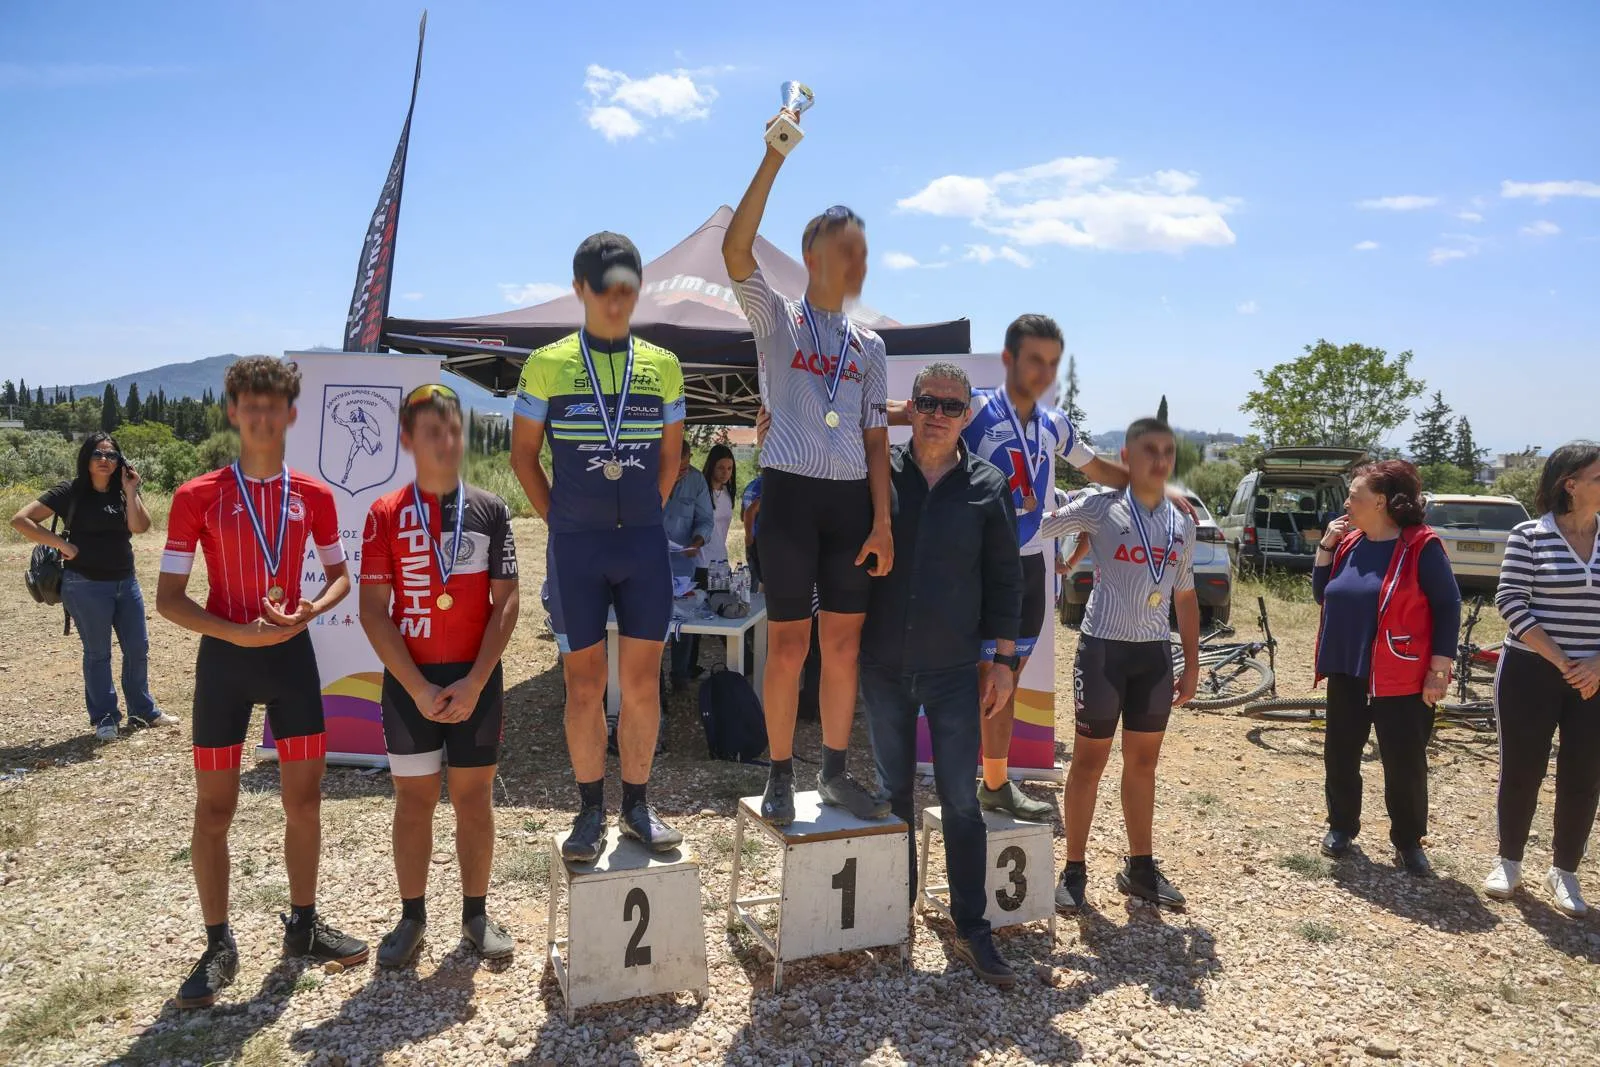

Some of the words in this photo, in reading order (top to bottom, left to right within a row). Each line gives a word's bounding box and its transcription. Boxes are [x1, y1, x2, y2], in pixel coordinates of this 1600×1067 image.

[831, 857, 857, 930] 1
[994, 845, 1028, 912] 3
[623, 887, 652, 969] 2
